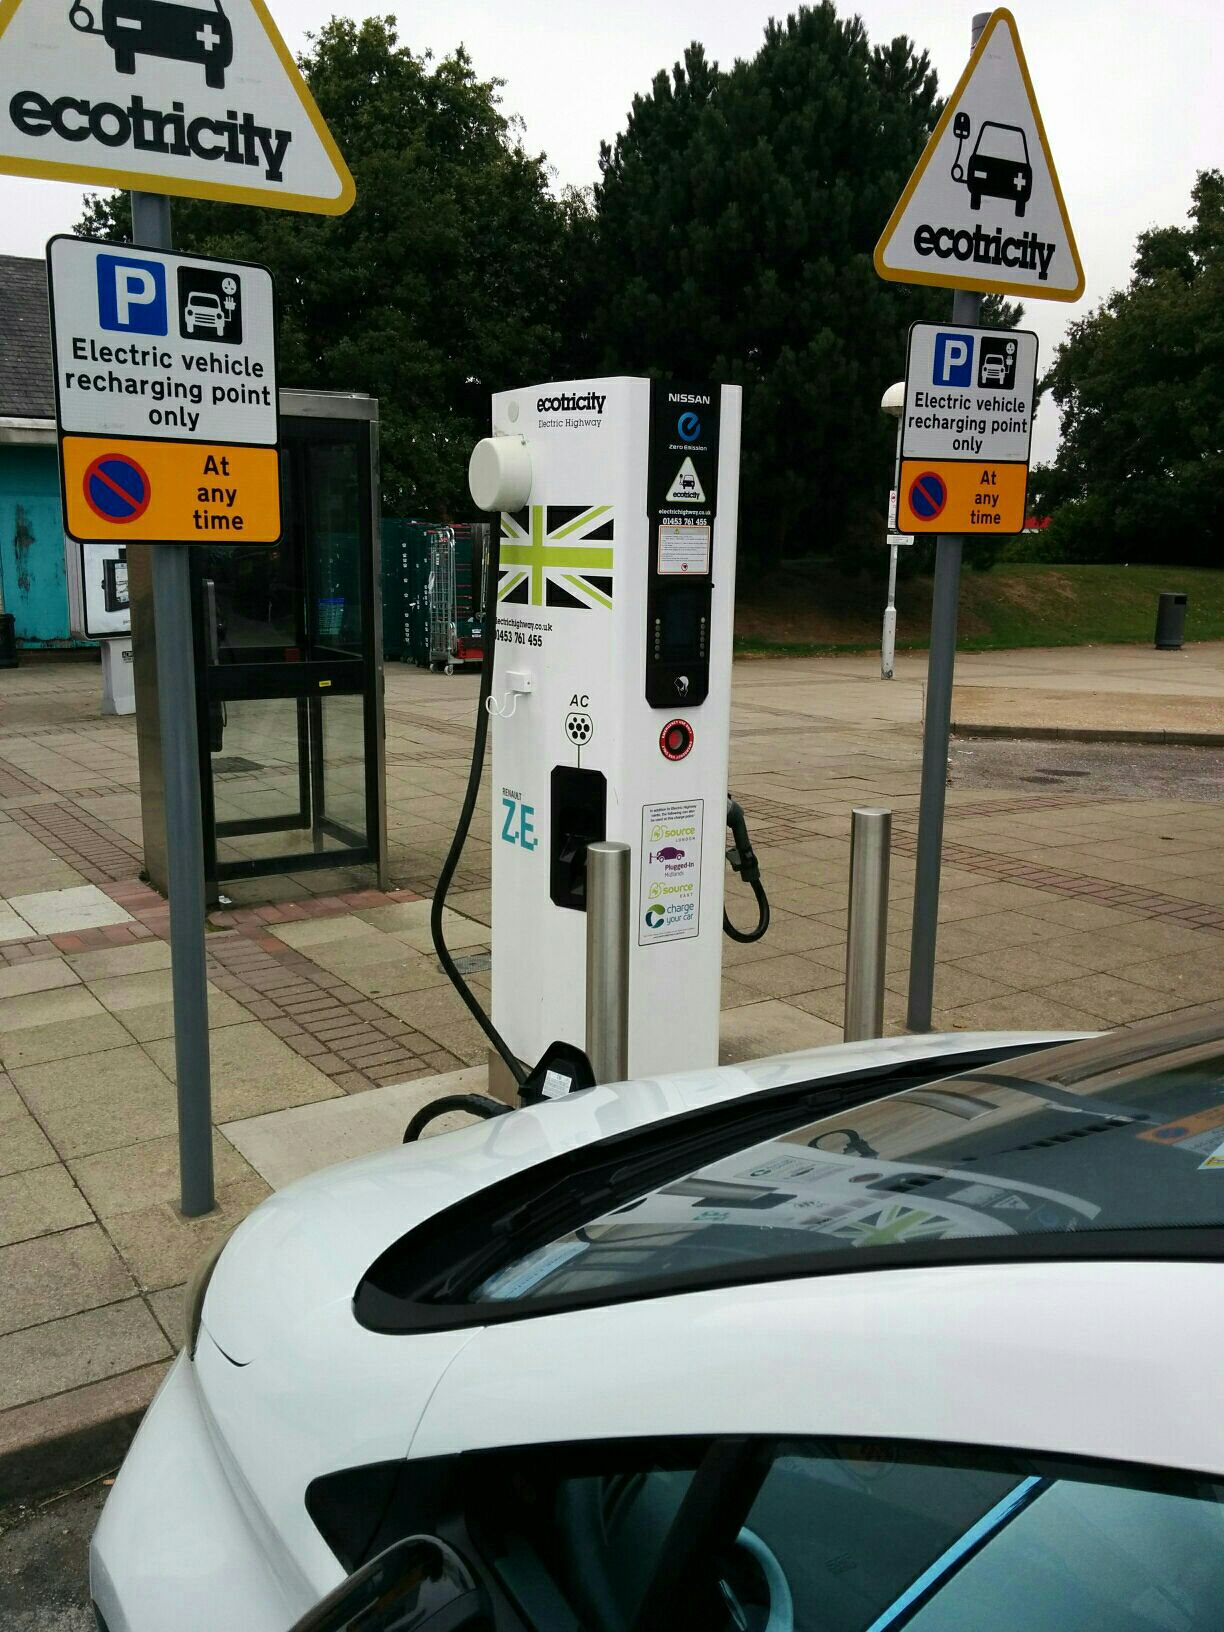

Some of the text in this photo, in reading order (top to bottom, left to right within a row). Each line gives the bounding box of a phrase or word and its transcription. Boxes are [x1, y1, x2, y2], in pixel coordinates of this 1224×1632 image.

[9, 90, 292, 182] ecotricity
[913, 224, 1056, 280] ecotricity
[115, 265, 156, 325] P
[72, 338, 264, 378] Electric vehicle
[942, 339, 968, 381] P
[65, 371, 271, 406] recharging point
[537, 392, 606, 414] ecotricity
[668, 393, 710, 404] NISSAN
[914, 392, 1025, 413] Electric vehicle
[149, 405, 200, 431] only
[538, 419, 601, 428] Electric Highway
[908, 414, 1027, 434] recharging point
[952, 436, 983, 454] only
[203, 455, 230, 477] At
[980, 470, 997, 485] At
[197, 485, 237, 507] any
[673, 491, 700, 500] ecotricity
[974, 493, 999, 508] any
[193, 510, 244, 531] time
[662, 517, 682, 525] 01453
[970, 510, 1001, 525] time
[496, 617, 553, 631] lectrichighway.co.uk
[495, 629, 543, 647] 1453 761 455
[569, 694, 589, 708] AC
[502, 787, 522, 800] RENAULT
[664, 826, 696, 838] source
[663, 882, 693, 895] source
[667, 903, 694, 914] charge
[666, 913, 693, 926] your car
